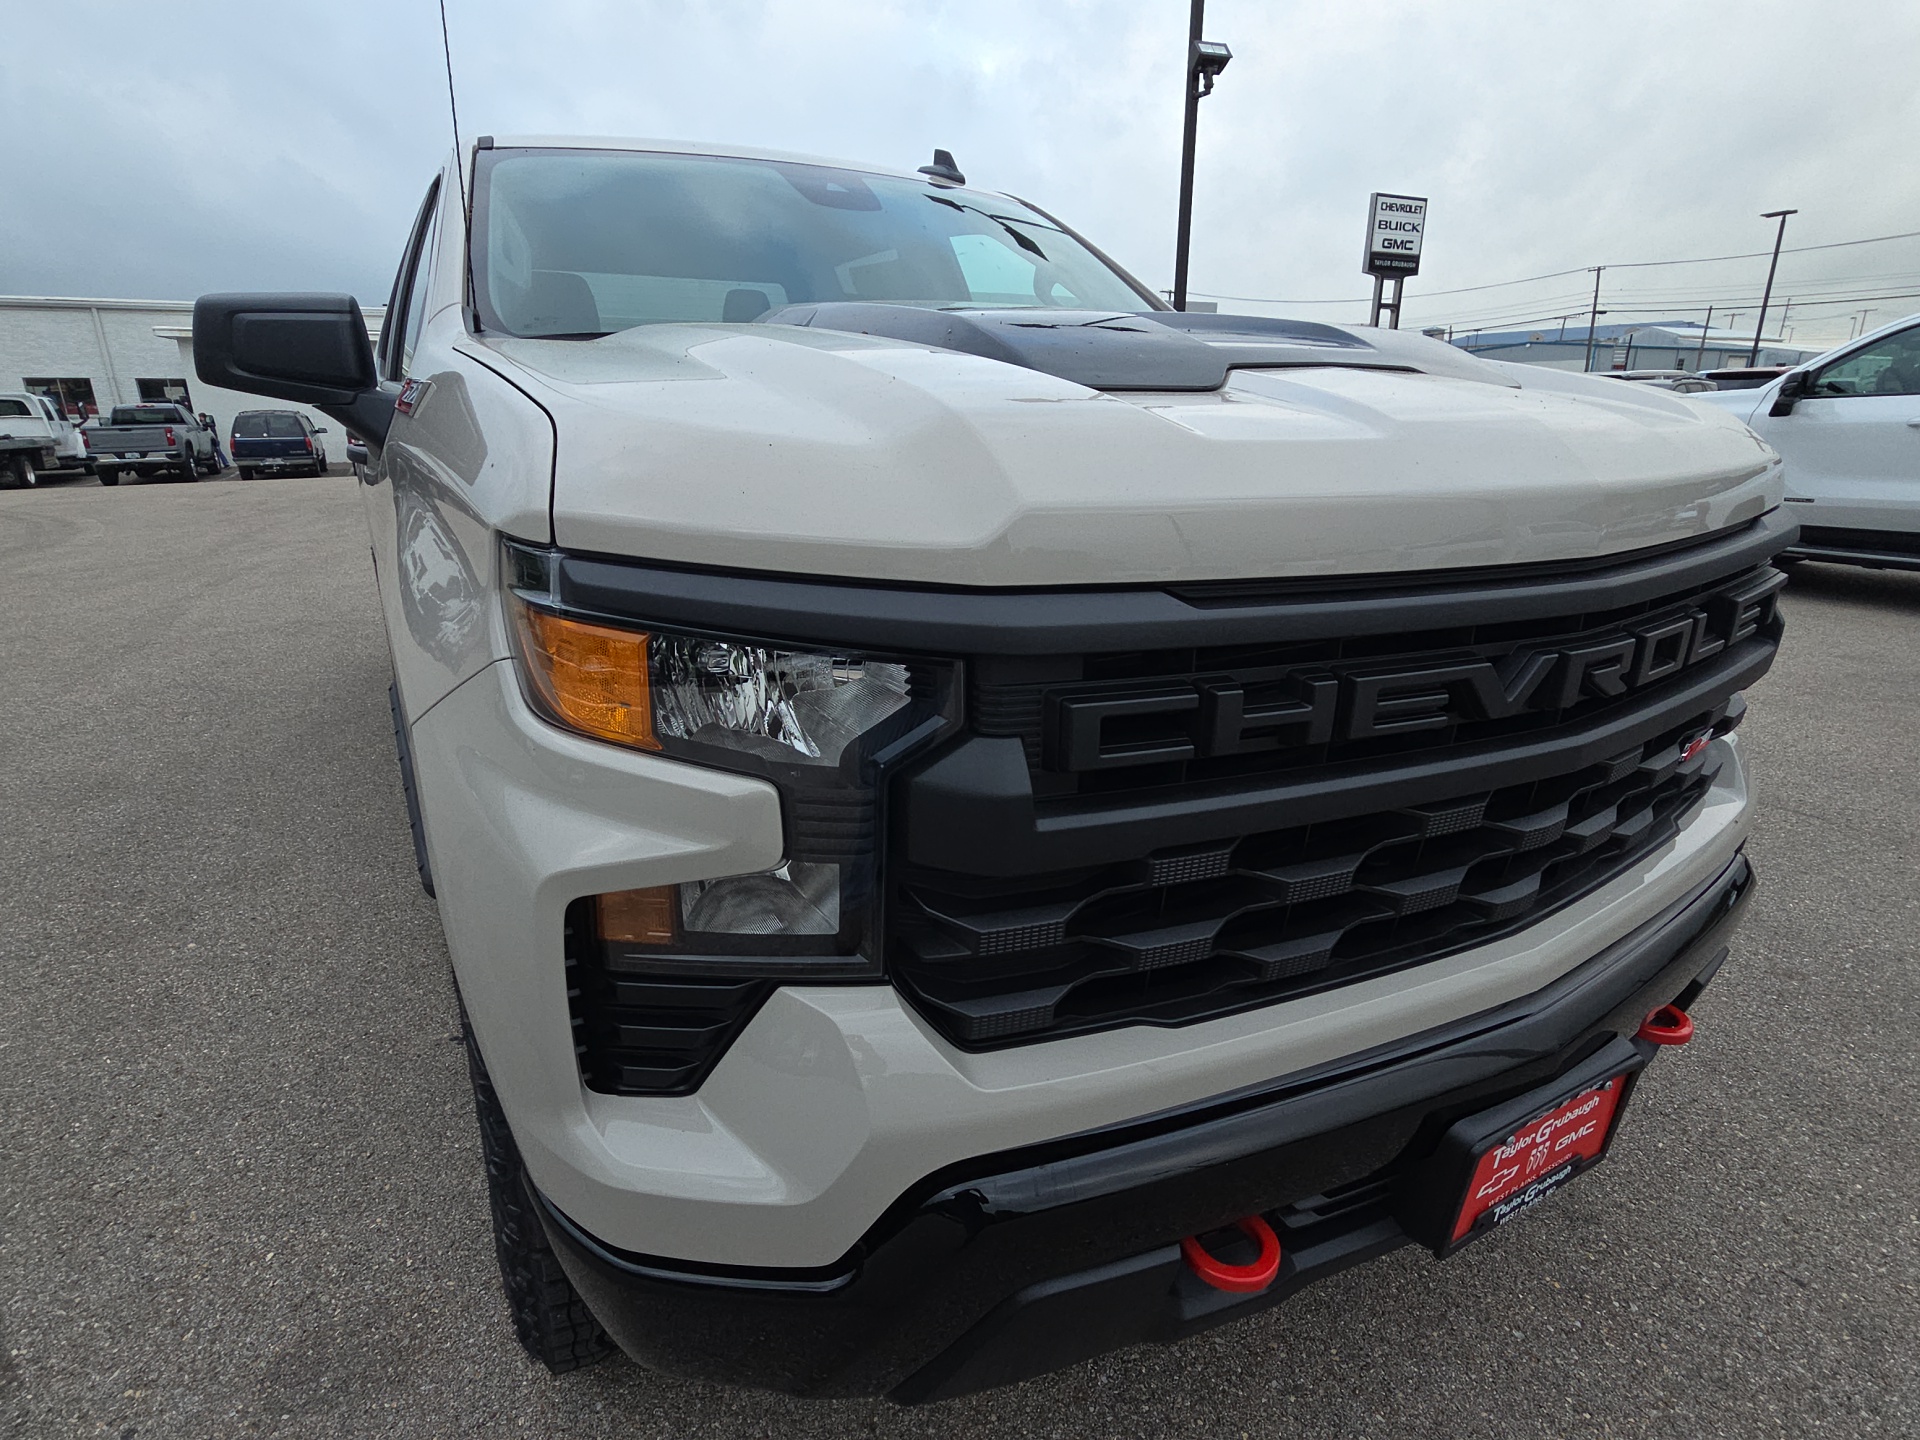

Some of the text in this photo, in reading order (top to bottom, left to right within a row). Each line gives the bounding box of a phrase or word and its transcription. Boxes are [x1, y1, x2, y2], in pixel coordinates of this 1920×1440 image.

[1381, 202, 1423, 214] CHEVROLET
[1378, 220, 1421, 233] BUICK
[1382, 238, 1414, 250] GMC
[1374, 259, 1391, 267] TAYLOR
[1492, 1095, 1600, 1169] Taylor Grubaugh
[1555, 1120, 1597, 1151] GMC
[1488, 1189, 1509, 1207] WEST
[1493, 1165, 1572, 1222] Taylor Grubaugh
